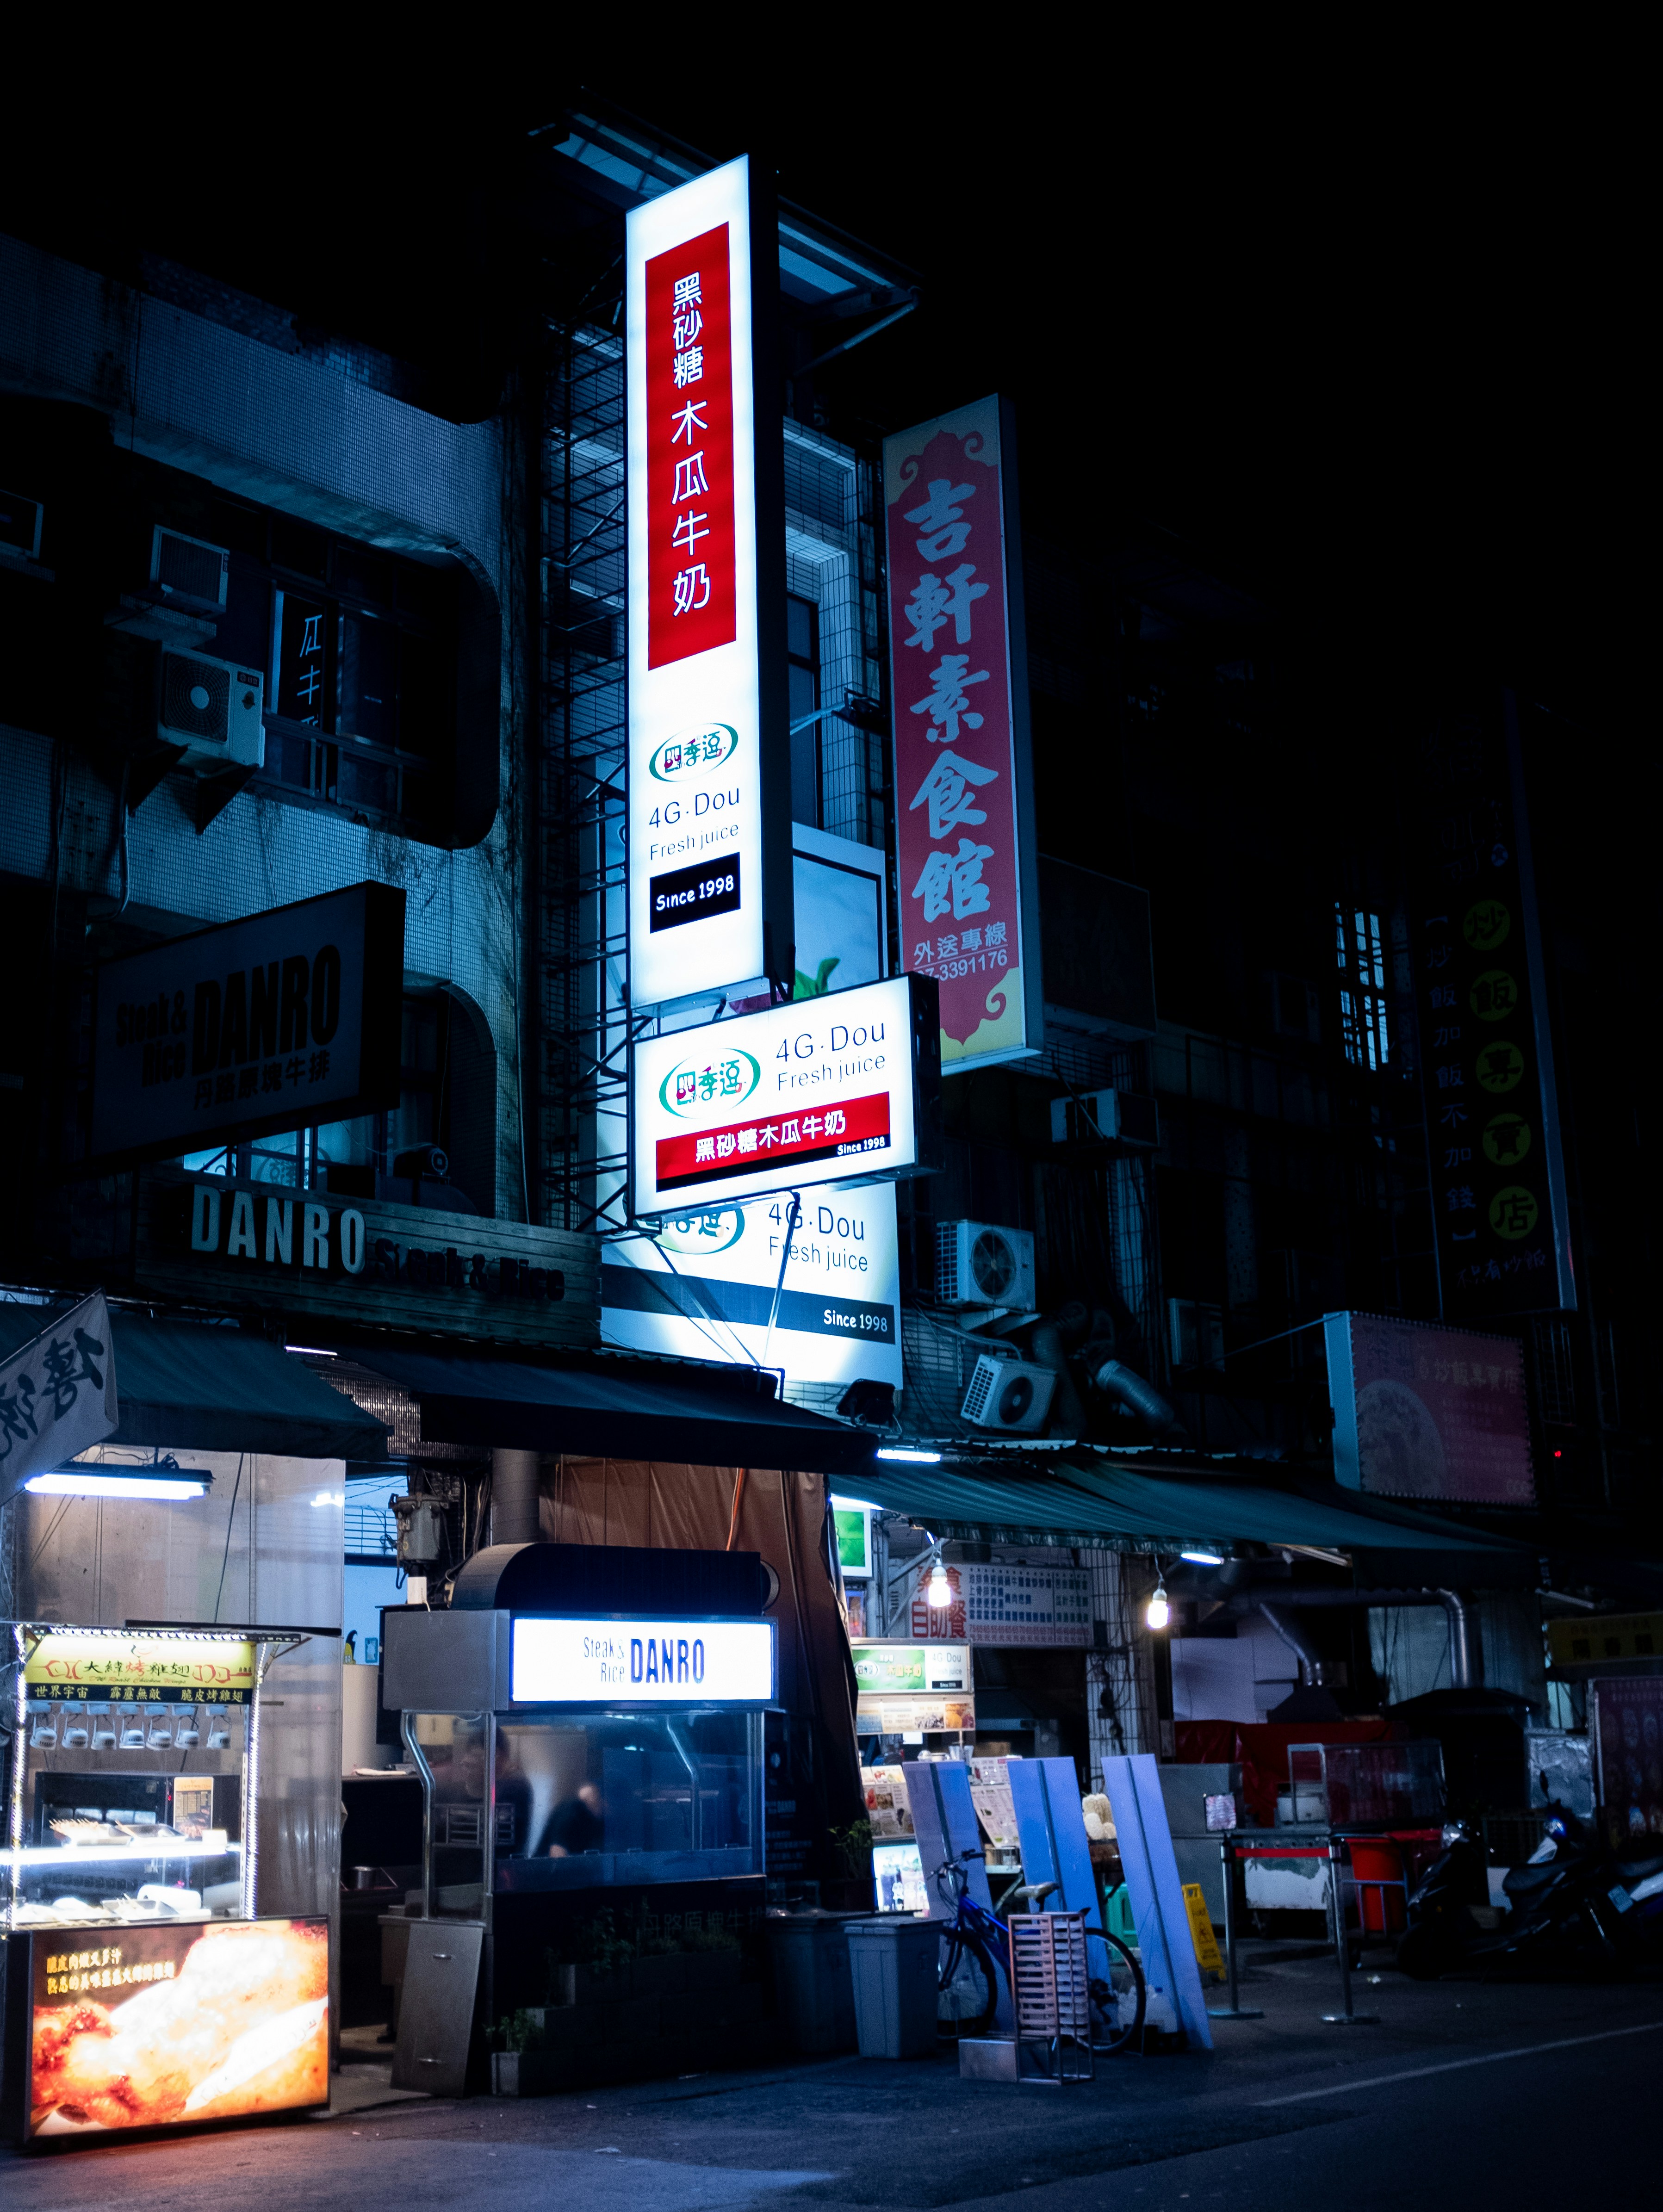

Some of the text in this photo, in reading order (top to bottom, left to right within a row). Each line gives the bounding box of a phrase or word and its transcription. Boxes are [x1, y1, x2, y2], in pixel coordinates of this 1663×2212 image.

[672, 272, 710, 617] 黑砂糖木瓜牛奶
[903, 478, 999, 923] 吉軒素食館
[651, 824, 738, 860] Fresh juice
[656, 874, 734, 911] Since 1998
[913, 921, 1007, 966] 外送專線
[917, 948, 1007, 981] 7-3391176
[117, 990, 187, 1047] Steak &
[192, 945, 341, 1076] DANRO
[142, 1041, 185, 1087] Rice
[194, 1050, 329, 1111] 丹路原塊牛排
[778, 1055, 885, 1091] Fresh juice
[1463, 902, 1536, 1234] 炒飯專賣店
[695, 1109, 847, 1163] 黑砂糖木瓜牛奶
[837, 1136, 885, 1156] Since 1998
[190, 1184, 565, 1300] DANRO Steak & Rice
[826, 1245, 868, 1271] juice
[823, 1309, 887, 1332] Since 1998
[912, 1597, 967, 1638] 自助餐
[583, 1636, 625, 1660] Steak &
[630, 1638, 704, 1684] DANRO
[35, 1685, 243, 1703] 世界宇宙 霹靂無敵 脆皮烤雞翅
[601, 1662, 625, 1683] Rice
